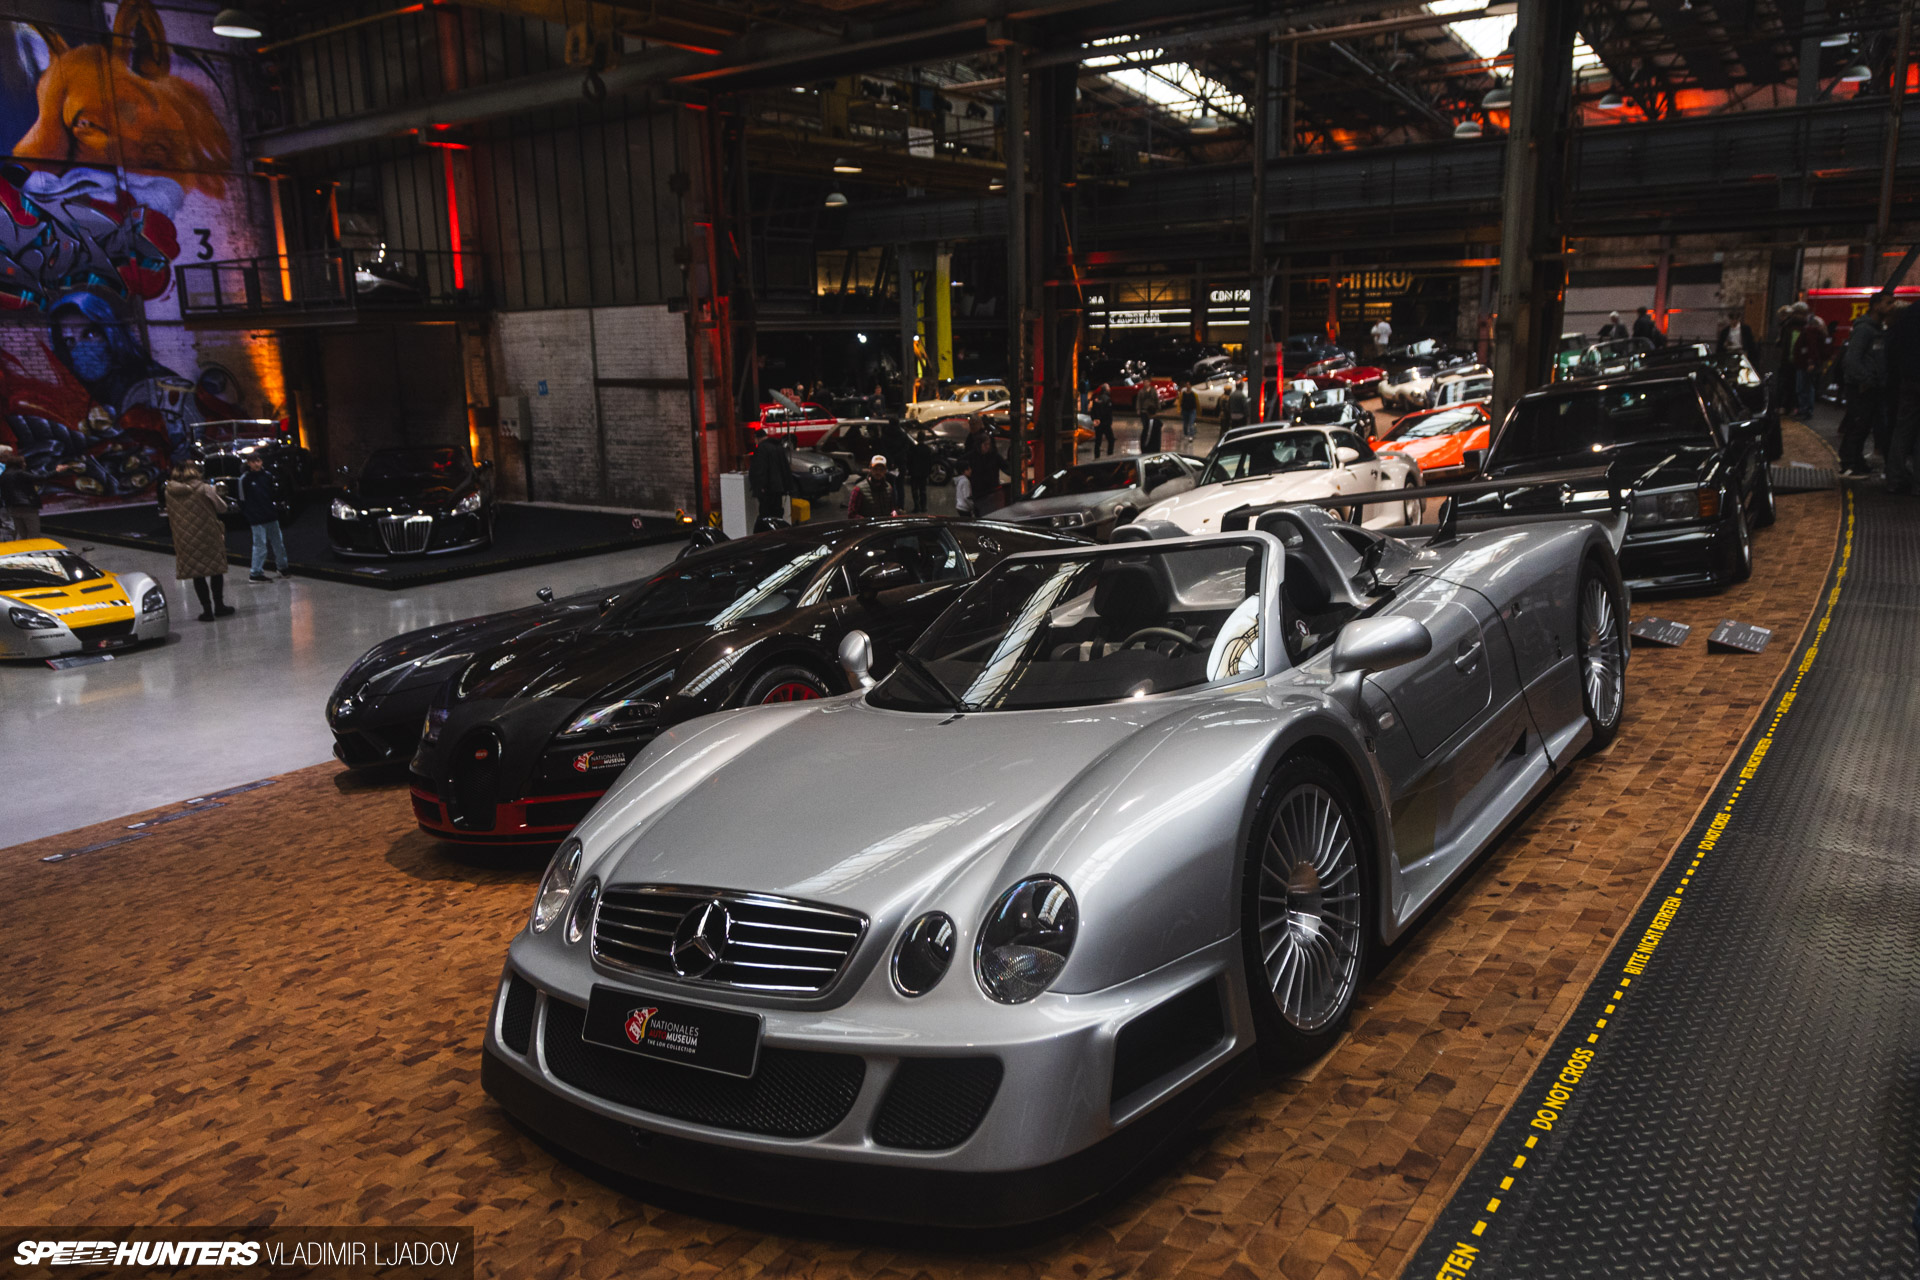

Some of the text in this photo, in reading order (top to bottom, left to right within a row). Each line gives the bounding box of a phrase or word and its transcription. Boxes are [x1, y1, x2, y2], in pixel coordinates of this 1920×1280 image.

[193, 228, 214, 260] 3
[591, 752, 625, 761] NATIONALES
[1697, 840, 1716, 850] DO
[1622, 895, 1682, 975] BITTE NICHT BETRETEN
[650, 1019, 700, 1037] NATIONALES
[666, 1043, 696, 1054] COLLECTION
[1530, 1047, 1595, 1131] DO NOT CROSS
